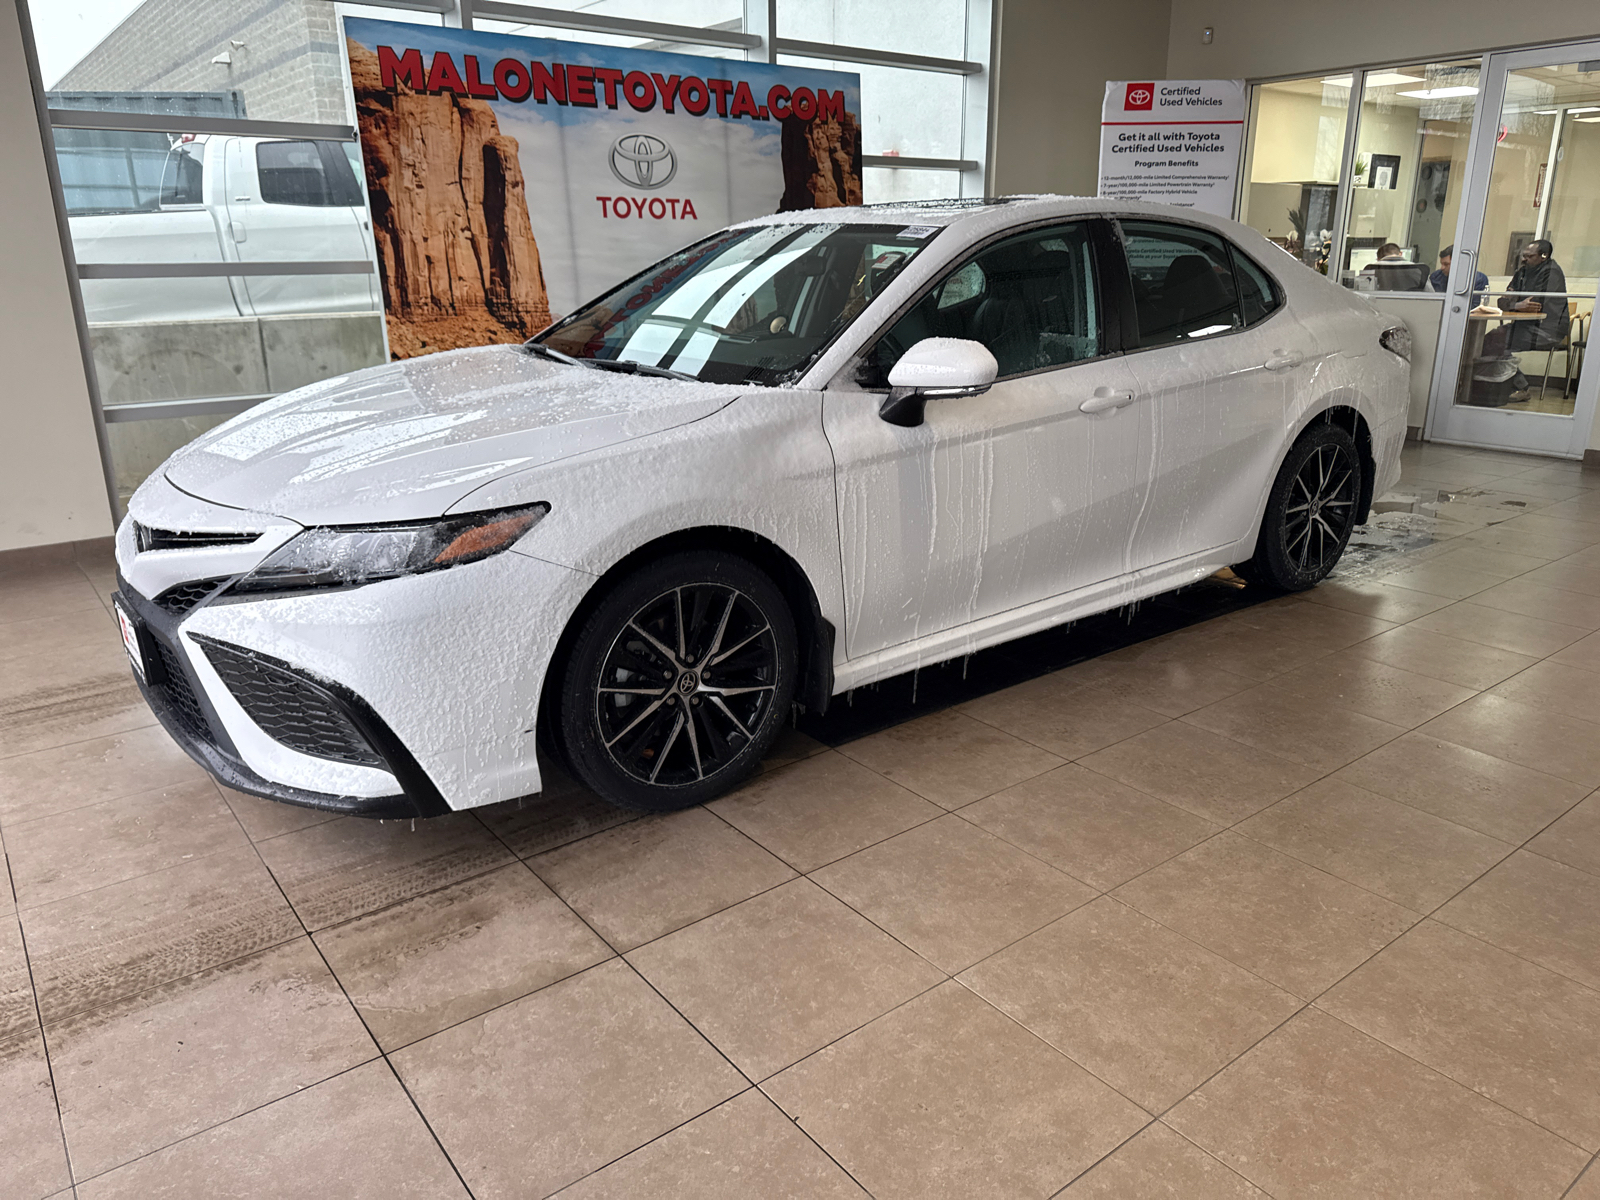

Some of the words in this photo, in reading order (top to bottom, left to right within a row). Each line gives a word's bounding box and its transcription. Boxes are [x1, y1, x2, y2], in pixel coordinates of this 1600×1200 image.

[376, 45, 846, 123] MALONETOYOTA.COM
[1160, 86, 1201, 96] Certified
[1159, 97, 1183, 107] Used
[1185, 97, 1223, 106] Vehicles
[1118, 133, 1136, 141] Get
[1138, 132, 1146, 141] it
[1147, 132, 1161, 141] all
[1163, 132, 1185, 141] with
[1187, 132, 1221, 142] Toyota
[1111, 144, 1155, 153] Certified
[1157, 143, 1182, 152] Used
[1184, 143, 1225, 152] Vehicles
[1134, 160, 1167, 169] Program
[1168, 159, 1199, 167] Benefits
[596, 196, 698, 220] TOYOTA
